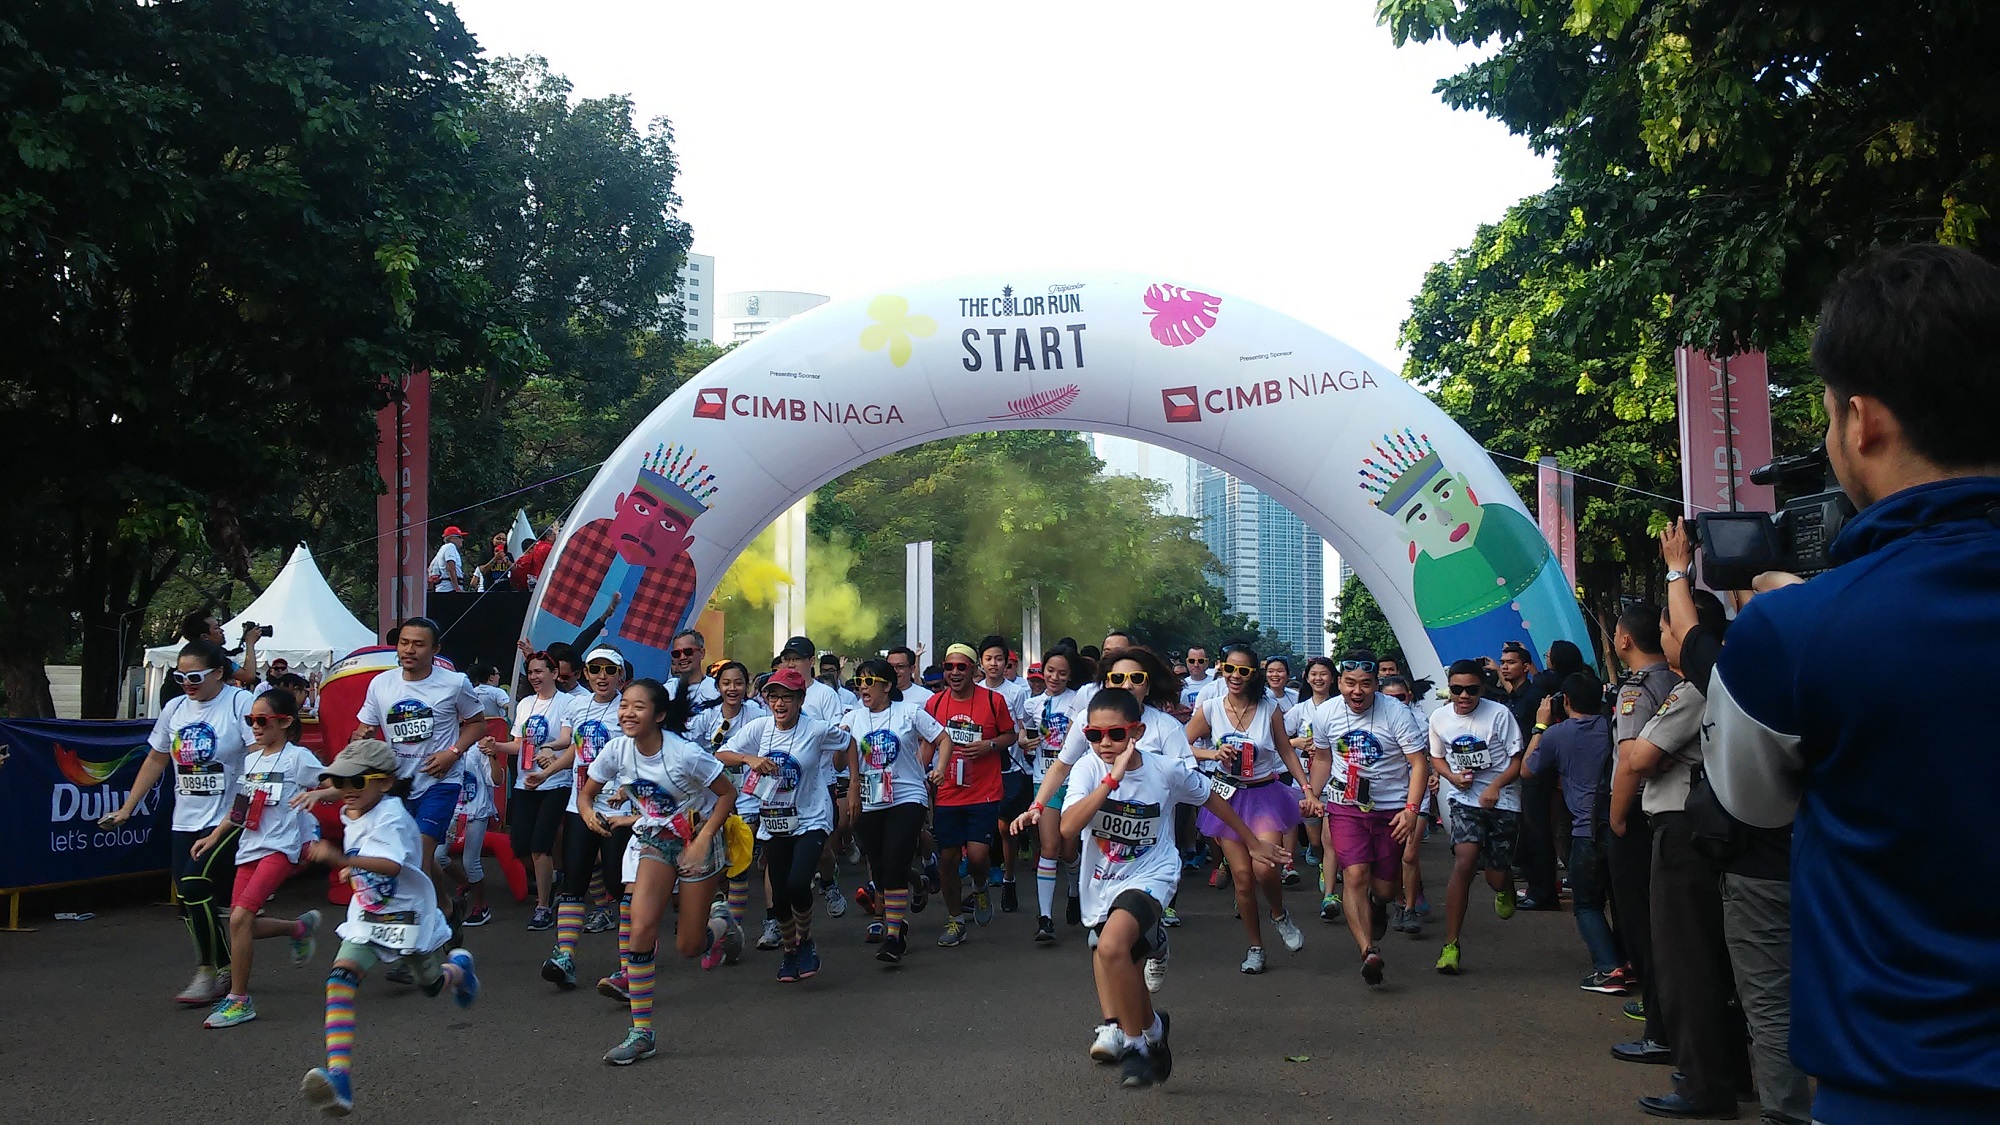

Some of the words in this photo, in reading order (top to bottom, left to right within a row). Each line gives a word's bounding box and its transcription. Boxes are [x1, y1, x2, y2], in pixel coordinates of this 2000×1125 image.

[959, 298, 989, 317] THE
[961, 323, 1086, 372] START
[1239, 353, 1269, 362] Presenting
[1270, 350, 1293, 358] Sponsor
[769, 371, 797, 379] Presenting
[798, 372, 821, 380] Sponsor
[1204, 380, 1282, 413] CIMB
[1288, 370, 1379, 400] NIAGA
[731, 394, 807, 422] CIMB
[813, 400, 904, 425] NIAGA
[182, 727, 202, 740] THE
[393, 720, 427, 737] 00356
[583, 725, 597, 736] THE
[180, 738, 213, 752] COLOR
[870, 733, 885, 745] THE
[1348, 734, 1365, 747] THE
[1456, 752, 1485, 766] 08042
[182, 776, 217, 790] 08946
[1102, 814, 1151, 838] 08045
[93, 826, 153, 848] colour
